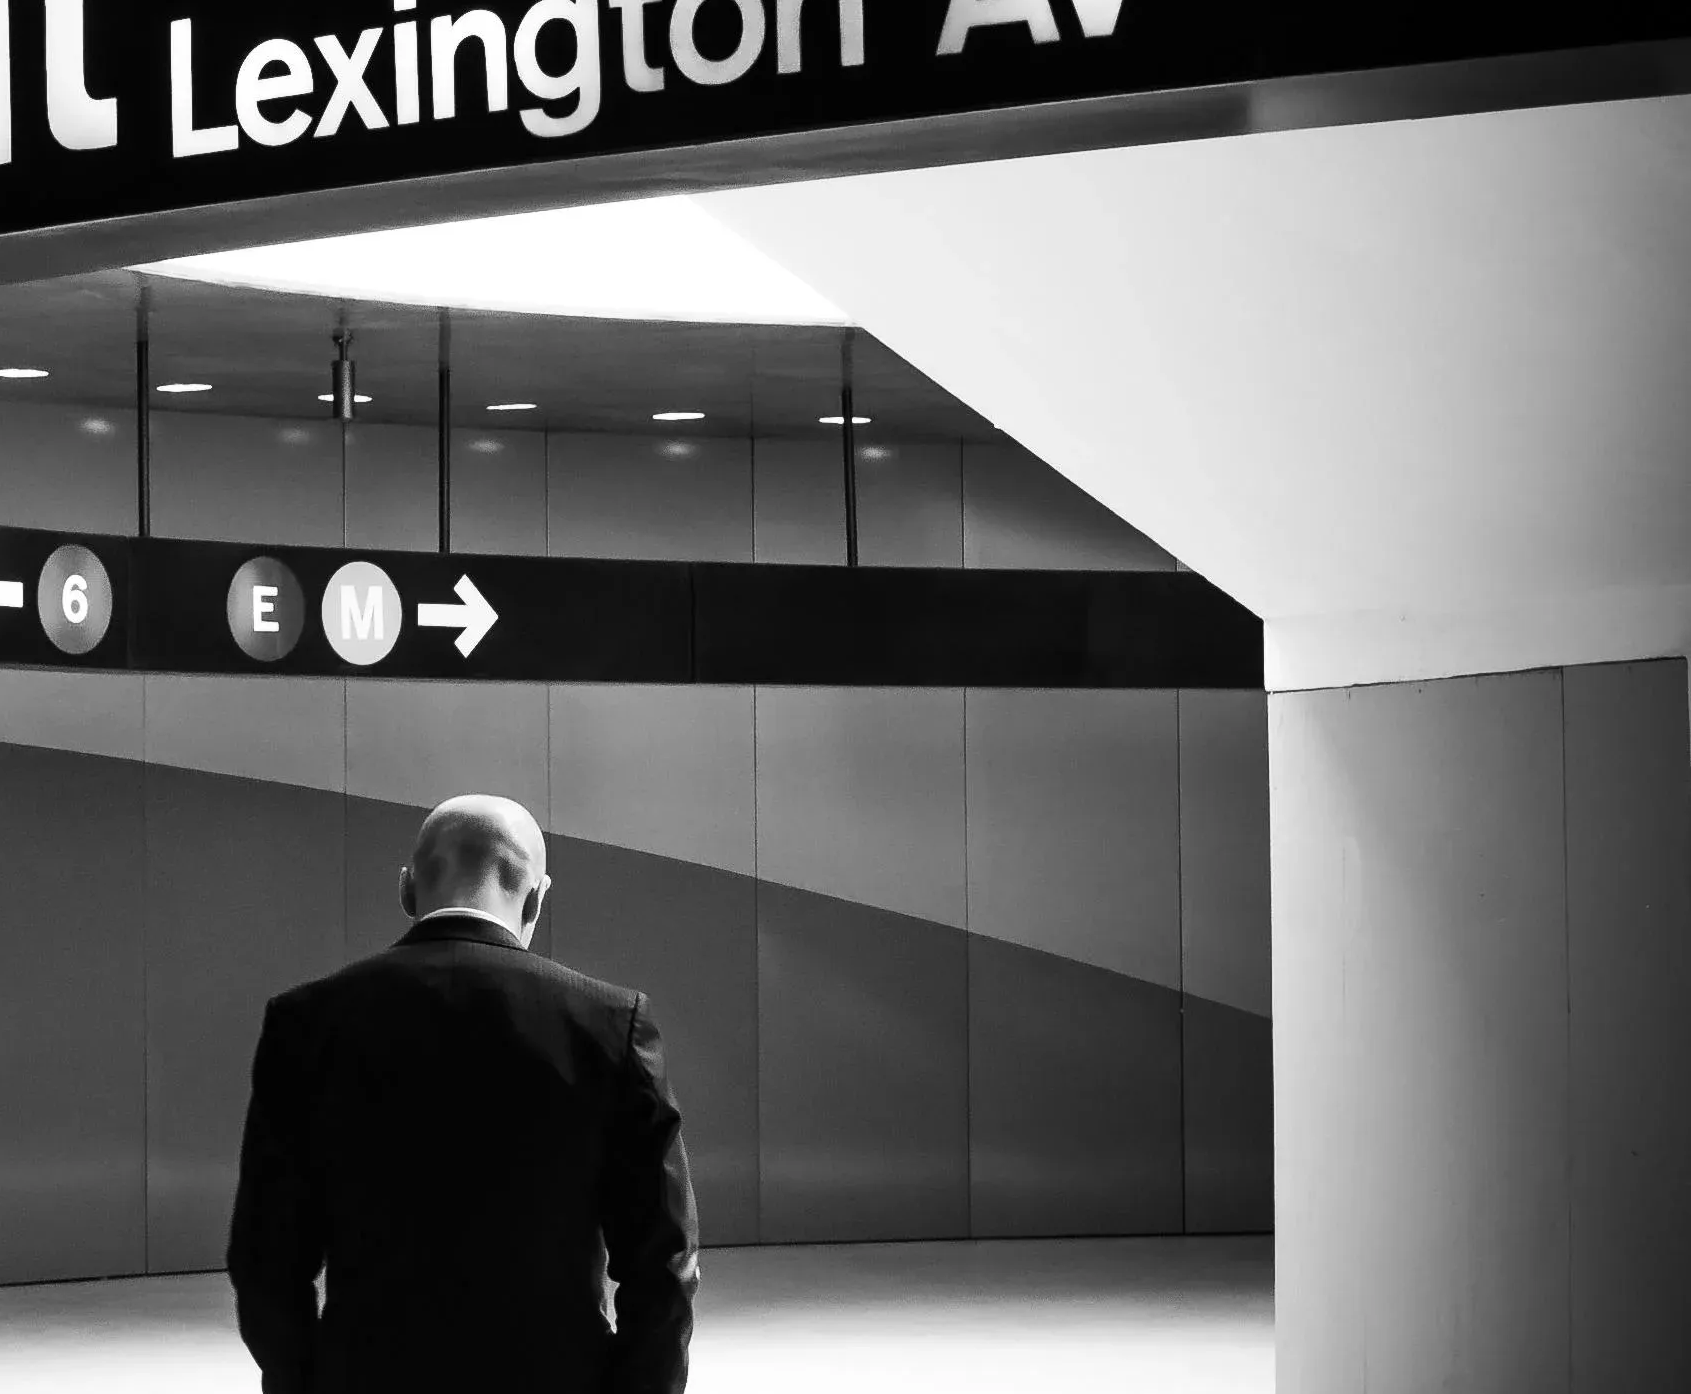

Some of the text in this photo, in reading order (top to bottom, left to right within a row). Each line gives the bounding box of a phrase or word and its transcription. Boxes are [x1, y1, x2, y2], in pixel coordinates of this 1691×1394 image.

[61, 574, 89, 624] 6
[252, 584, 385, 641] E M
